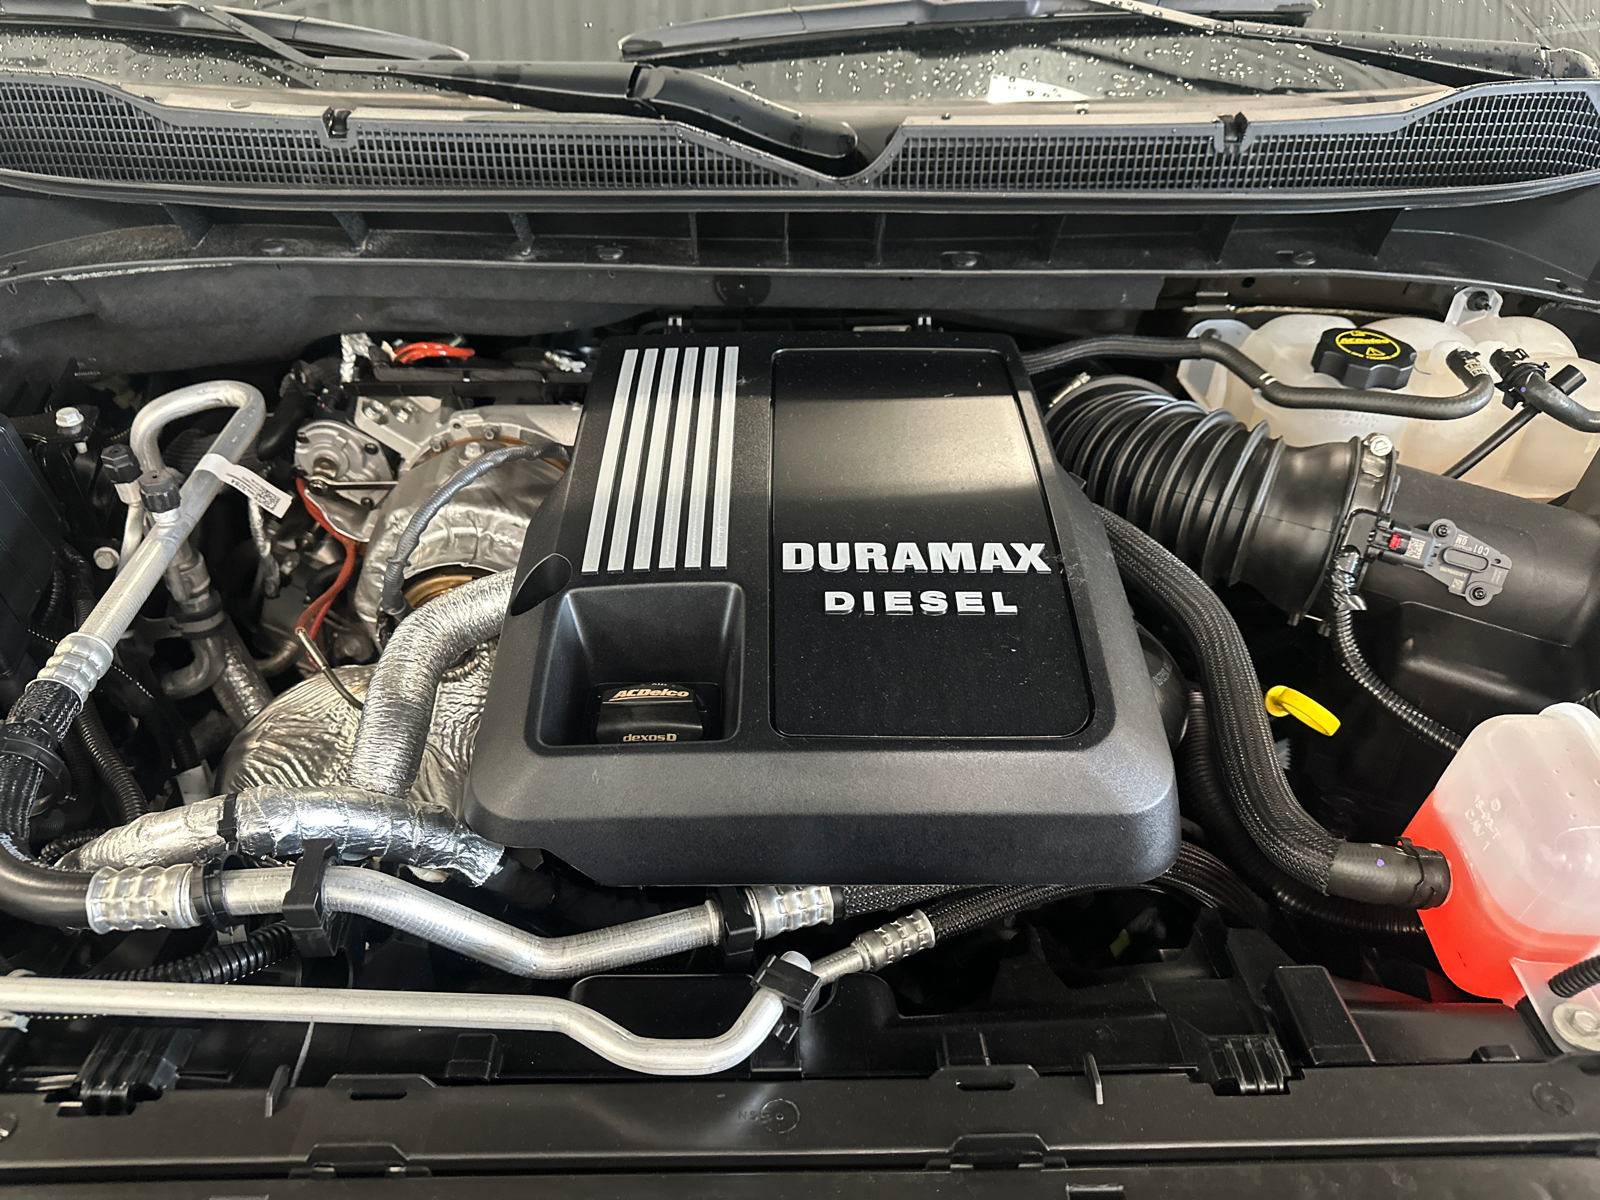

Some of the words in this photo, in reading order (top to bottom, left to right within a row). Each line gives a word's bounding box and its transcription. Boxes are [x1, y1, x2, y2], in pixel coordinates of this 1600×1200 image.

[1455, 534, 1468, 546] GM
[1473, 544, 1490, 557] C01
[782, 542, 1052, 573] DURAMAX
[824, 590, 1018, 616] DIESEL
[612, 688, 690, 699] ACDelco
[622, 733, 678, 742] dexosD
